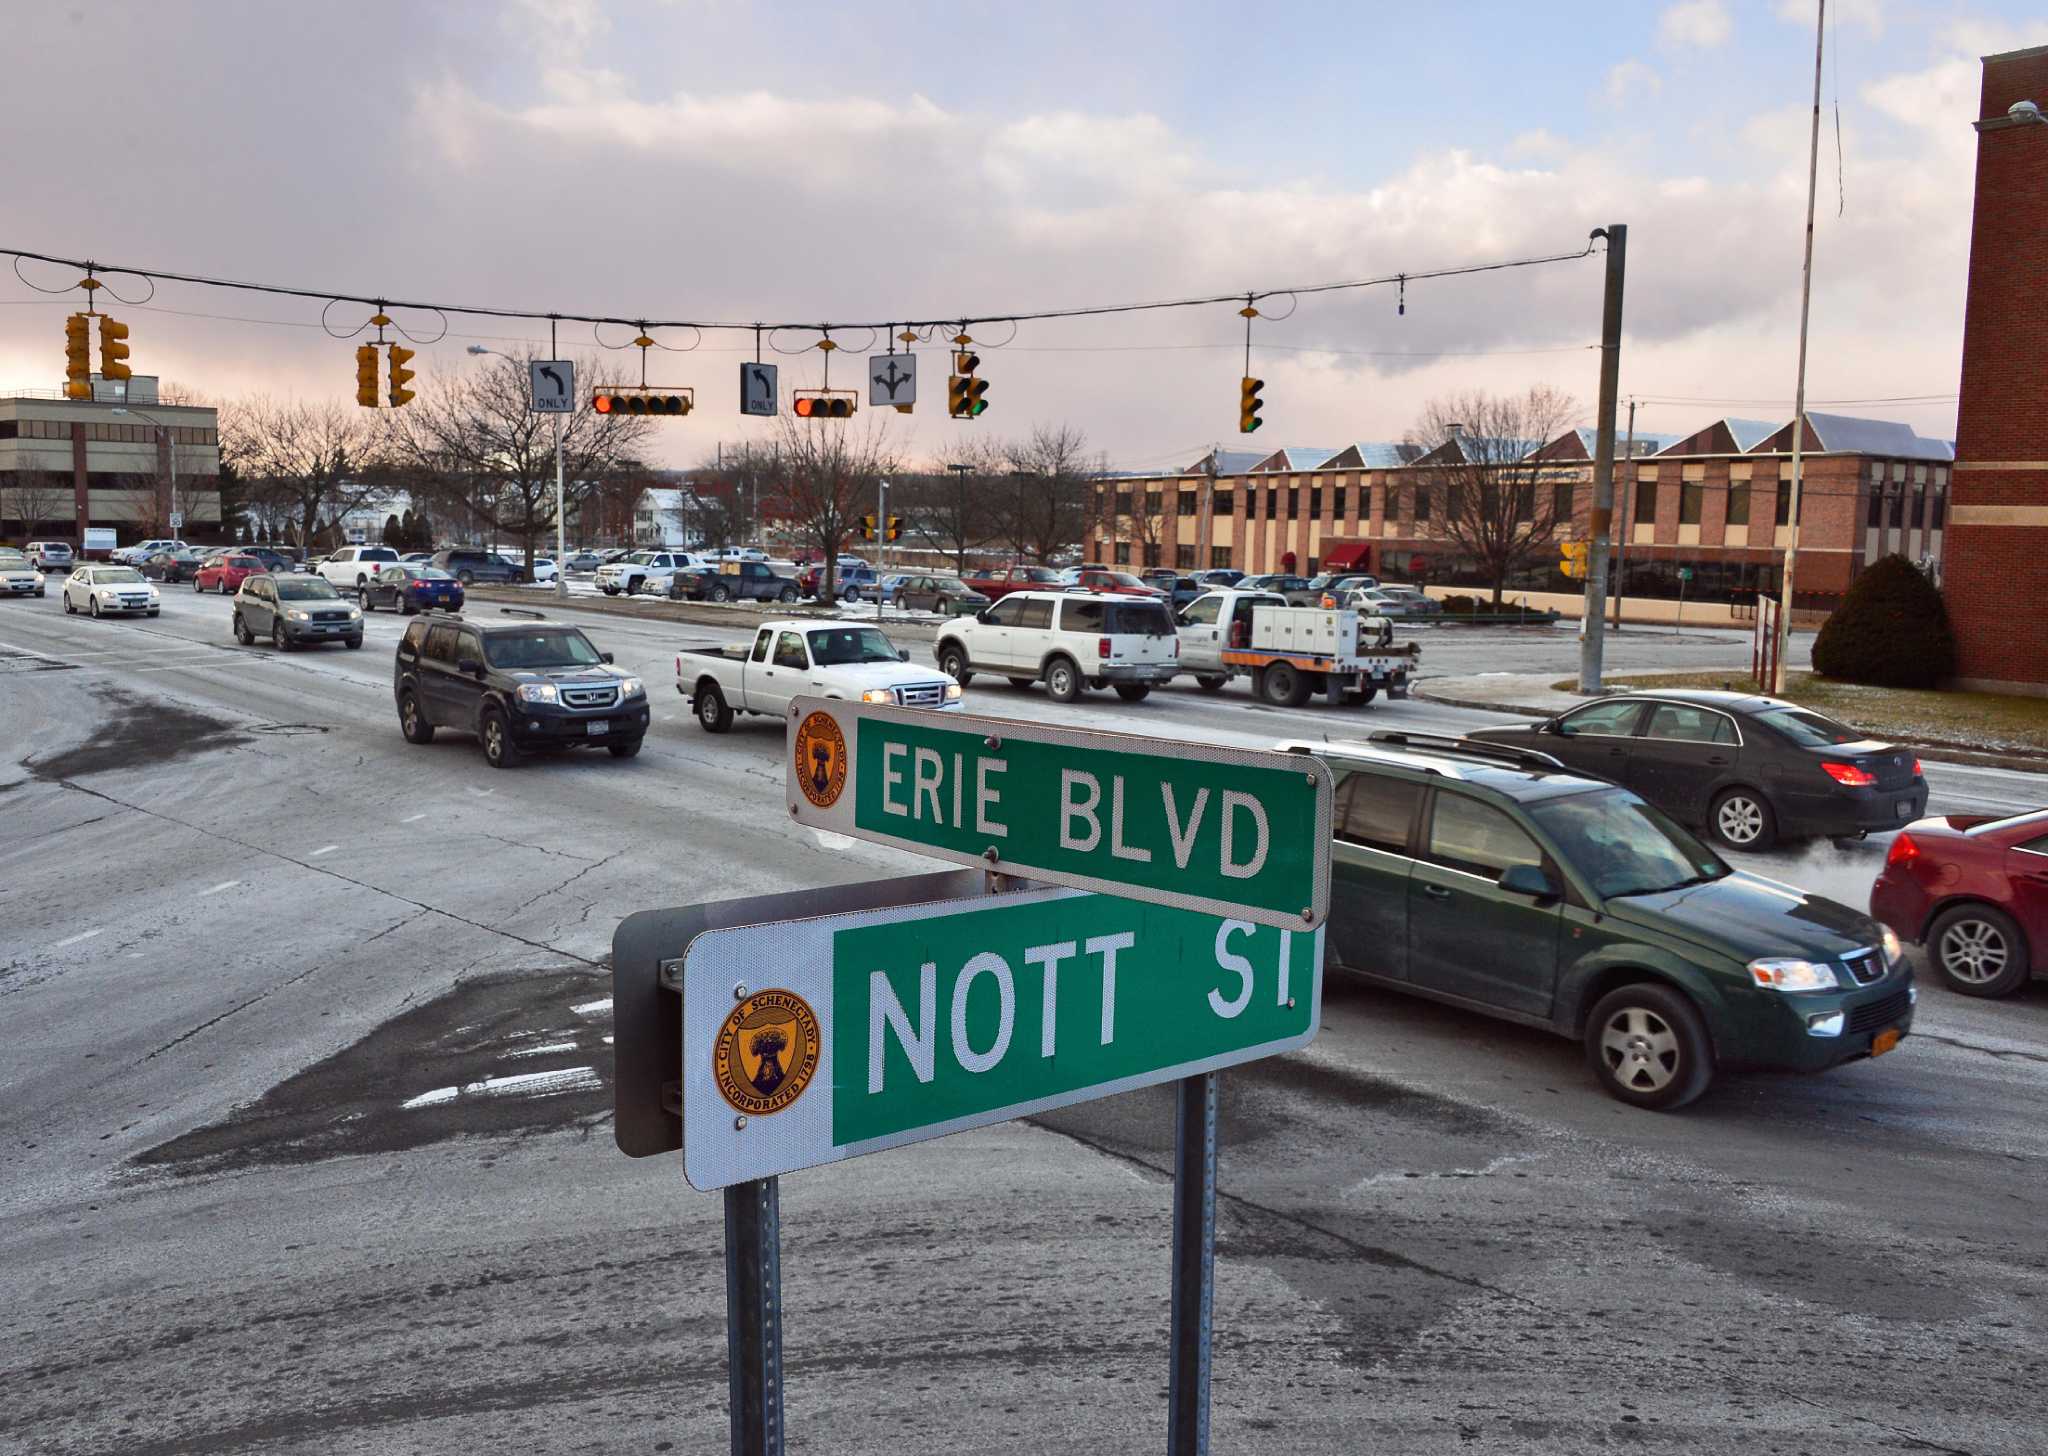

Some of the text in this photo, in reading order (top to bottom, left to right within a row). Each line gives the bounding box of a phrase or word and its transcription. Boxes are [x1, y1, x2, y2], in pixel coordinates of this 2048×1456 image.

[538, 398, 568, 409] ONLY
[751, 399, 774, 411] ONLY
[883, 741, 1270, 880] ERIE BLVD
[719, 995, 816, 1061] CITY OF SCHENECTADY
[868, 931, 1136, 1095] NOTT
[720, 1053, 815, 1110] INCORPORATED 1798
